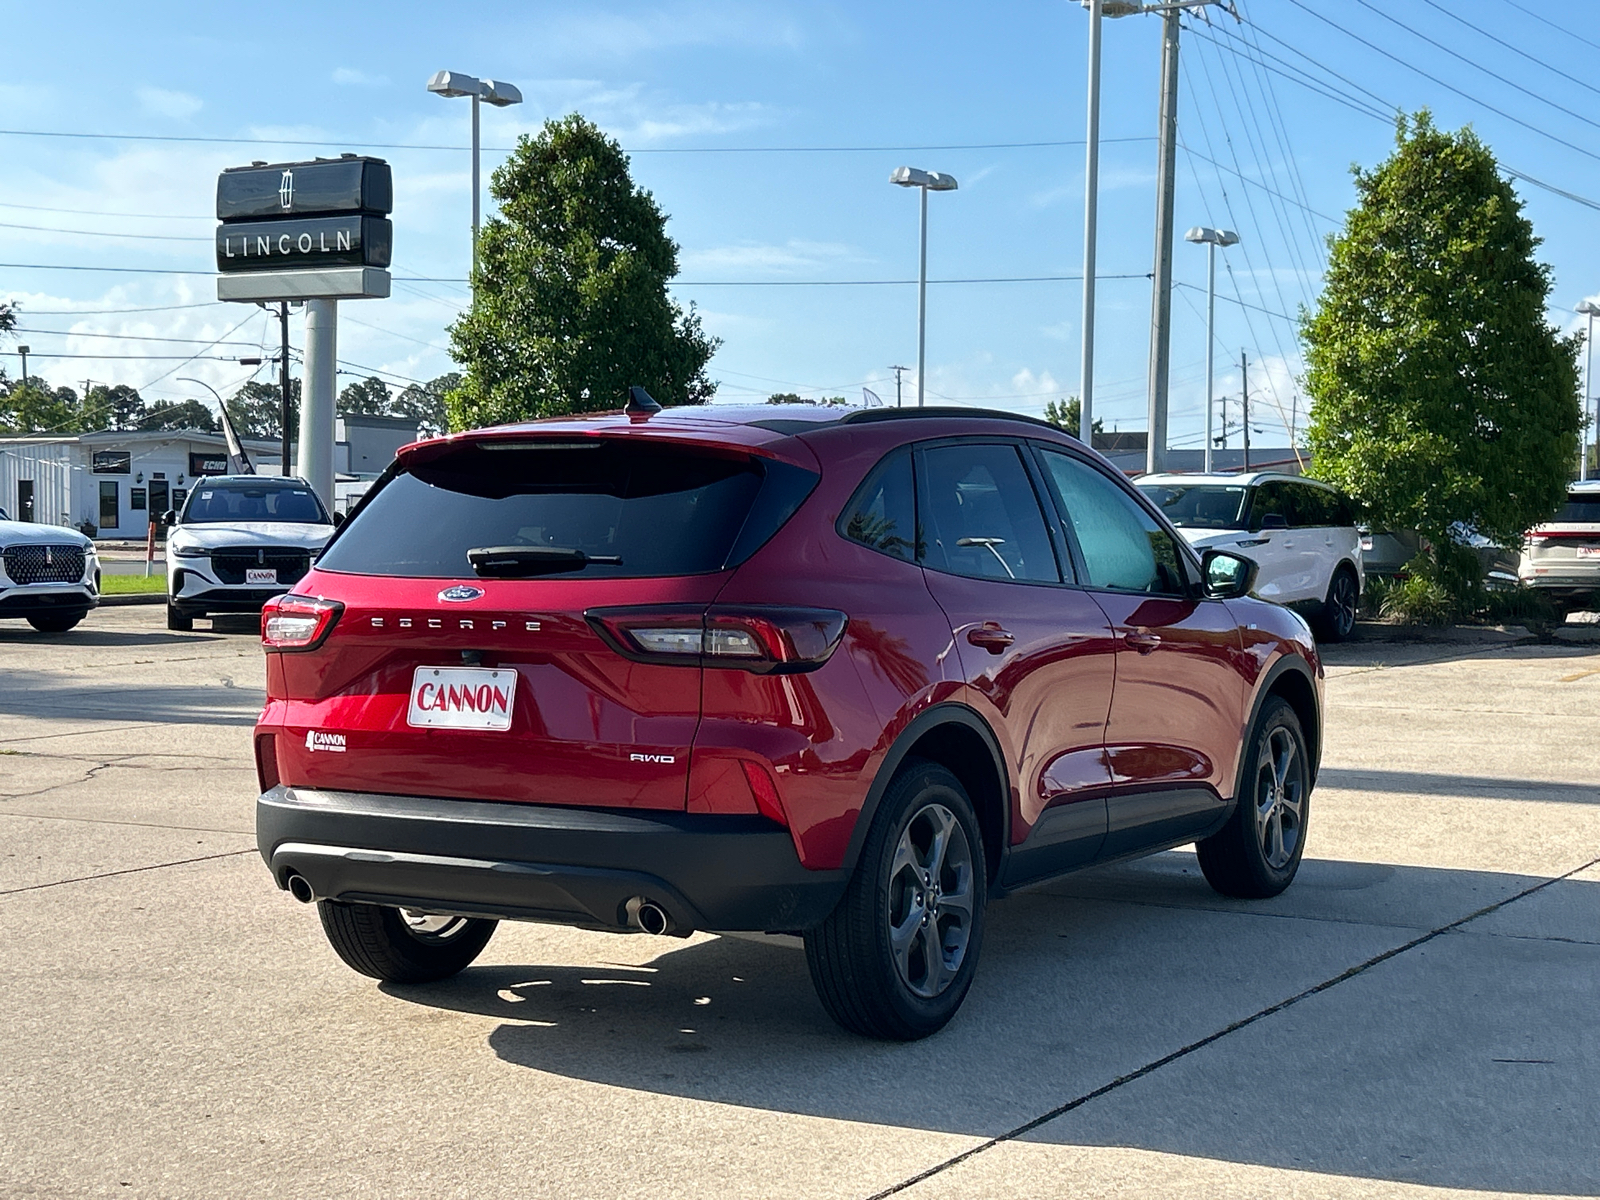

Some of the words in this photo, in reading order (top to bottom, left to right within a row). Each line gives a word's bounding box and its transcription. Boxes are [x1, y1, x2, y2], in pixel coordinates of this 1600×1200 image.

[225, 230, 351, 258] LINCOLN
[202, 460, 227, 470] ECHO
[371, 617, 541, 631] ESCAPE
[417, 682, 510, 713] CANNON
[314, 732, 347, 746] CANNON
[630, 753, 675, 764] AWD
